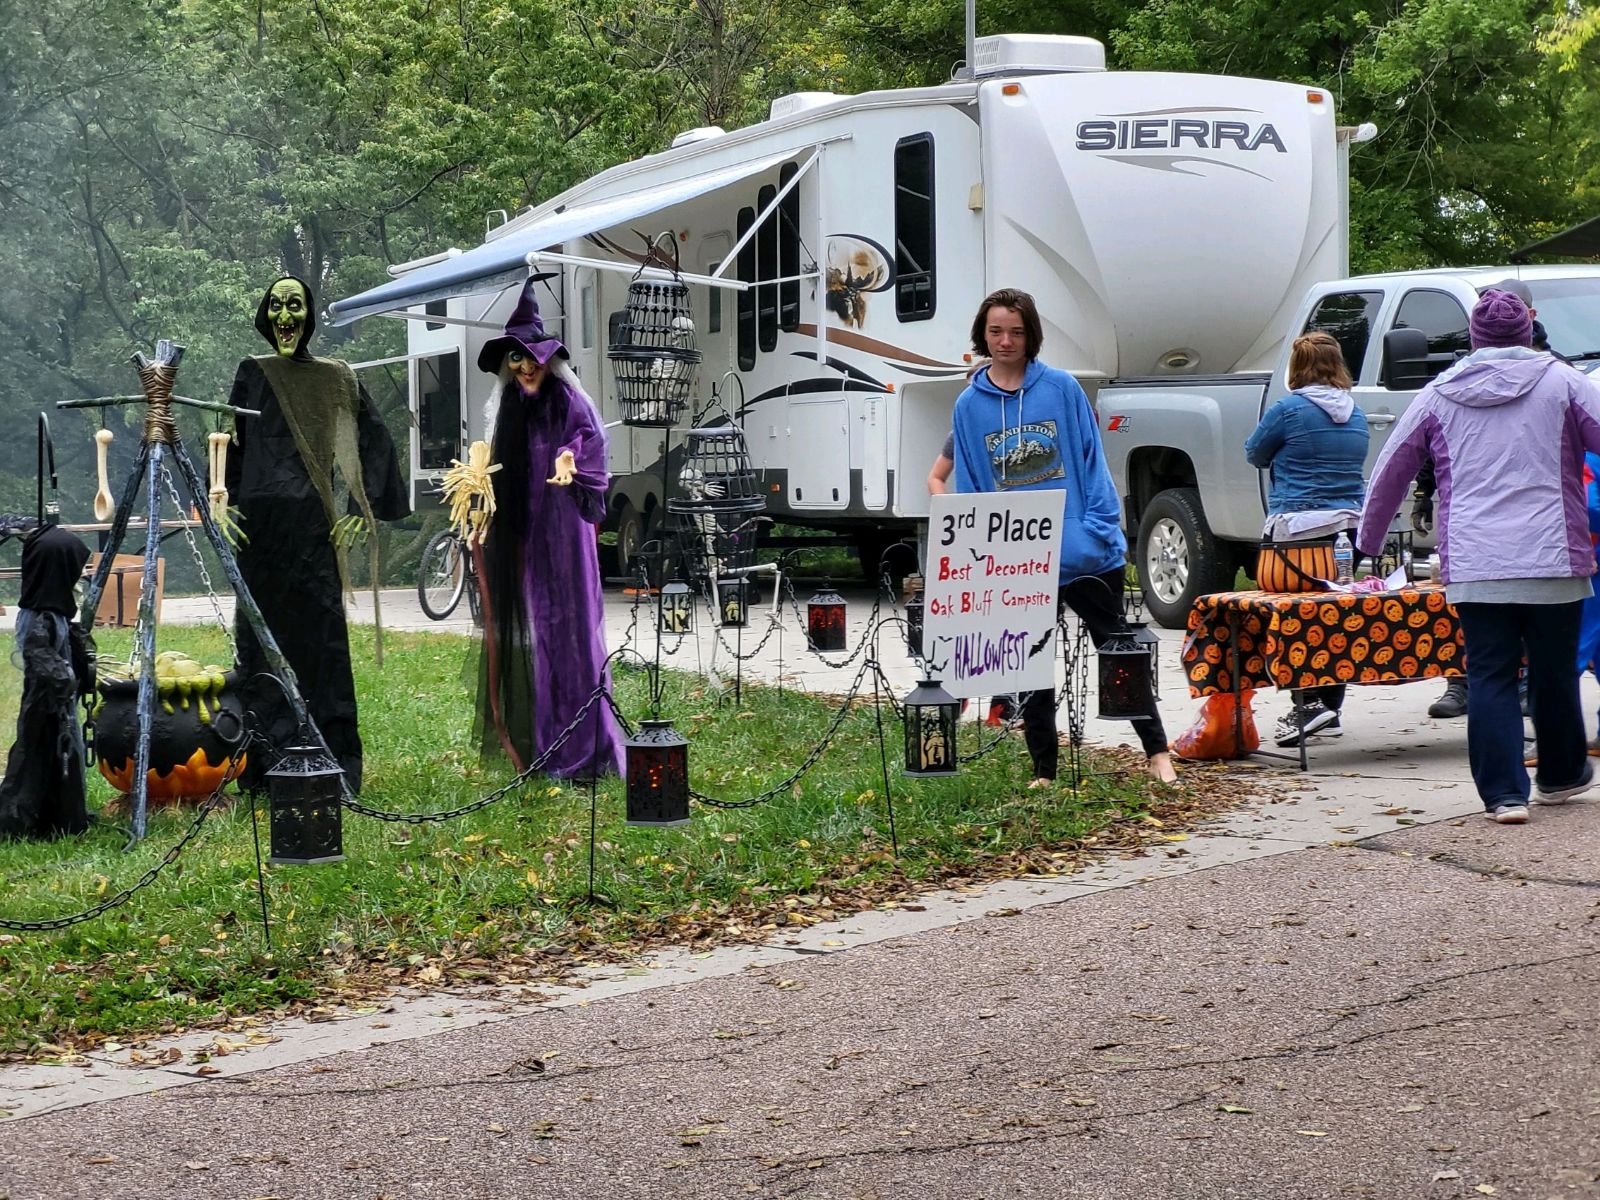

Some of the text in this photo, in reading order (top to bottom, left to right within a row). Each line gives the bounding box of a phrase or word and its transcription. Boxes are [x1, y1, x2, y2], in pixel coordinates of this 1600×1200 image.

[1075, 119, 1288, 153] SIERRA
[1022, 424, 1055, 439] TETON
[940, 506, 1052, 546] 3rd Place
[938, 551, 1051, 581] Best Decorated
[930, 588, 1051, 618] Oak Bluff Campsite
[954, 628, 1029, 681] HALLOWFEST
